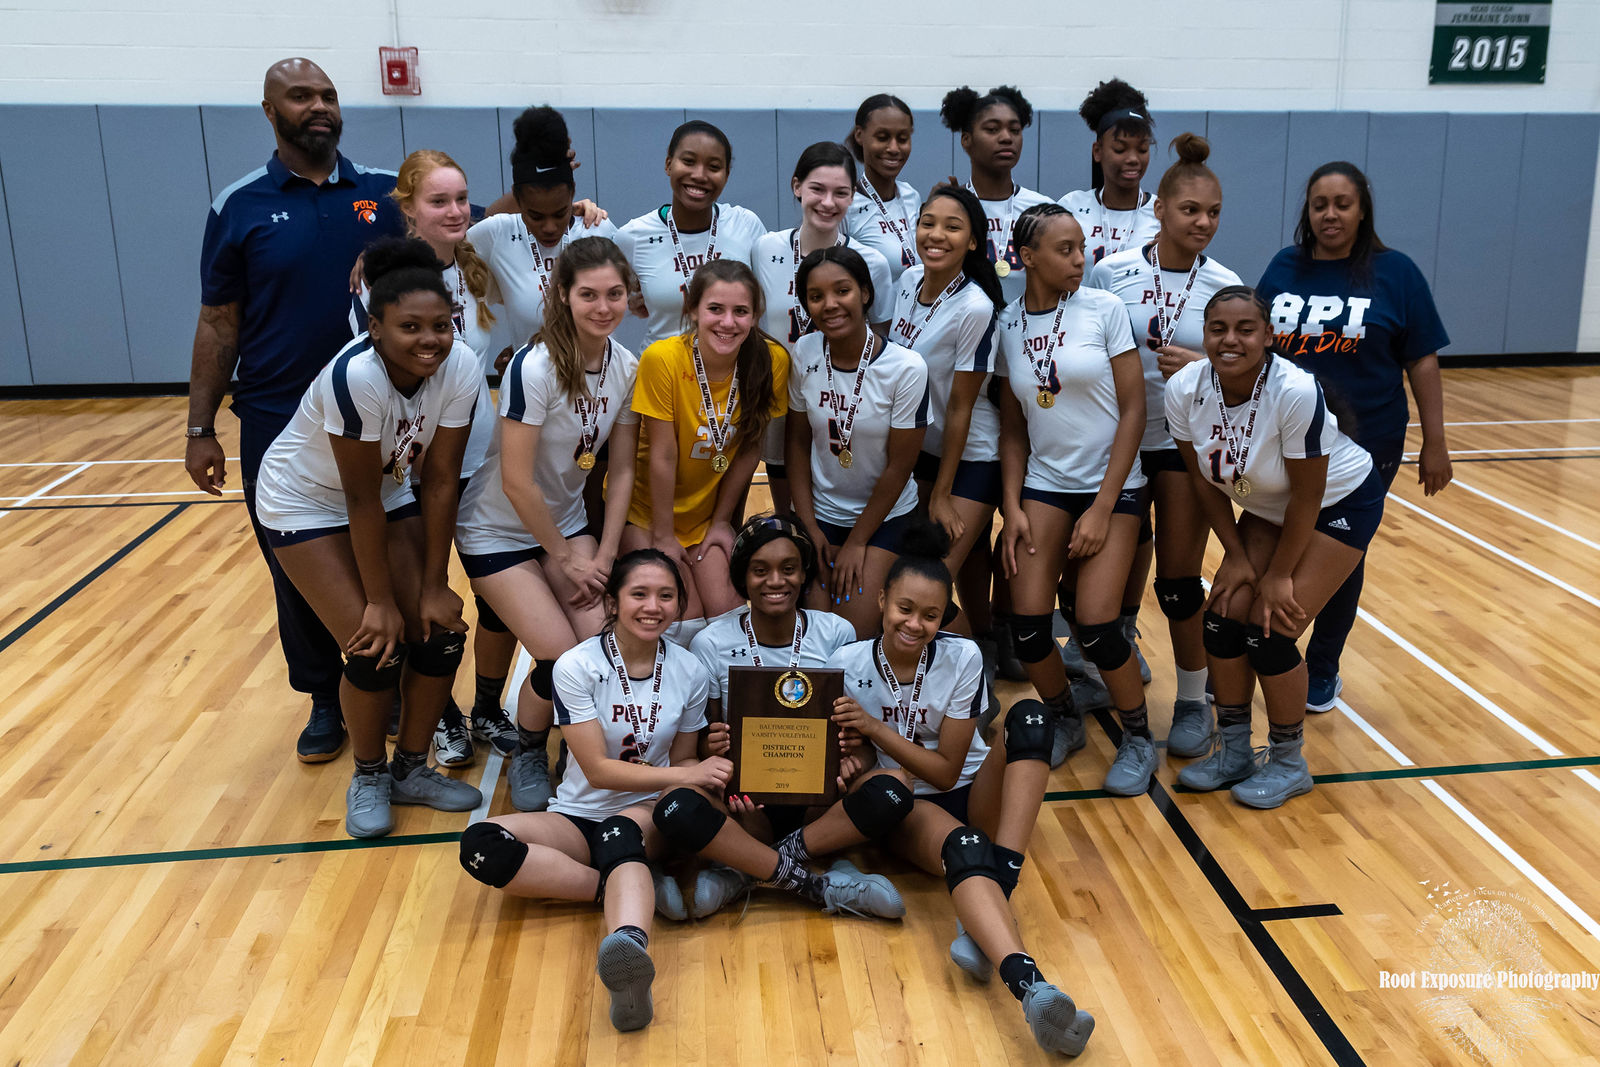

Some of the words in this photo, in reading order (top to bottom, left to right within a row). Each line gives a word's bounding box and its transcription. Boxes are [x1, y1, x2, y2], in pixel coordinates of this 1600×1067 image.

[1451, 14, 1500, 23] JERMAINE
[1502, 14, 1531, 23] DUNN
[1448, 35, 1531, 71] 2015
[352, 199, 378, 212] POLY
[894, 317, 917, 340] POL
[1314, 330, 1361, 354] Die!
[616, 665, 631, 695] VOLLEYBALL
[627, 703, 641, 735] VOLLEYBALL
[762, 751, 805, 759] CHAMPION
[885, 789, 902, 805] ACE
[664, 800, 679, 817] ACE
